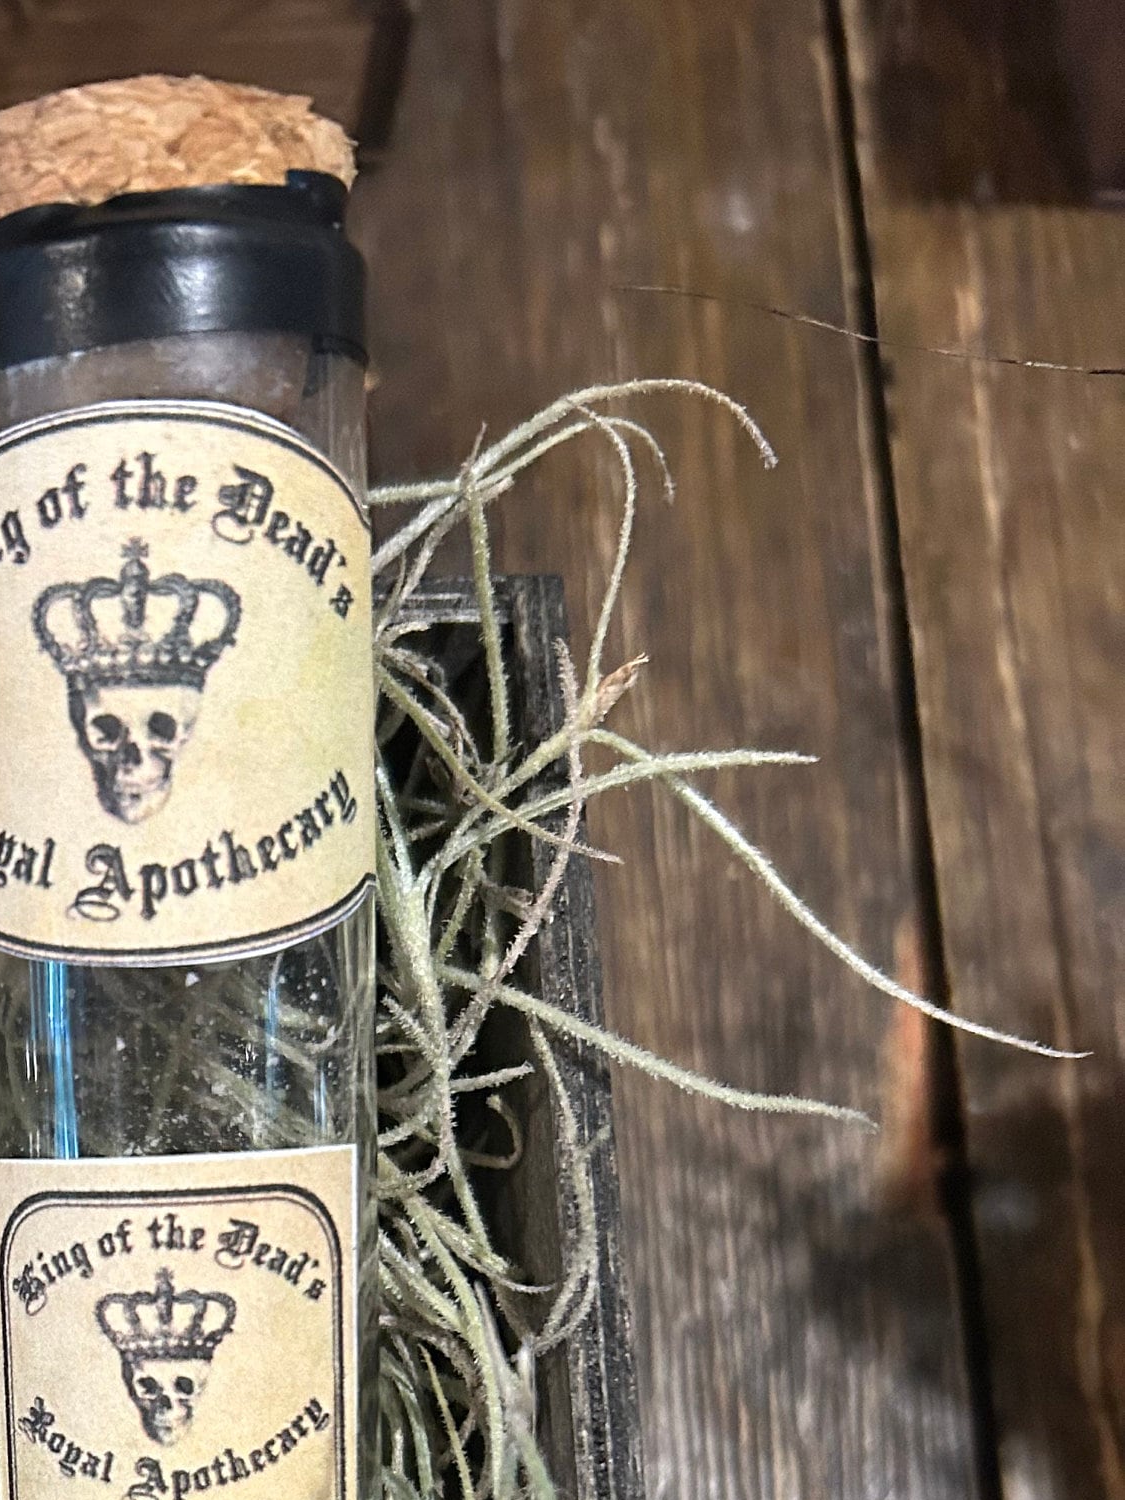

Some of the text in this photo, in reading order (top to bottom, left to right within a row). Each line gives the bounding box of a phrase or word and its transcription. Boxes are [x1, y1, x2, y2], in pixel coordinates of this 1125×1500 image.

[37, 463, 89, 529] of
[110, 451, 198, 512] the
[211, 463, 355, 620] Dead's
[67, 768, 358, 921] Apothecary
[12, 1213, 327, 1317] King of the Dead's
[19, 1397, 113, 1482] Royal
